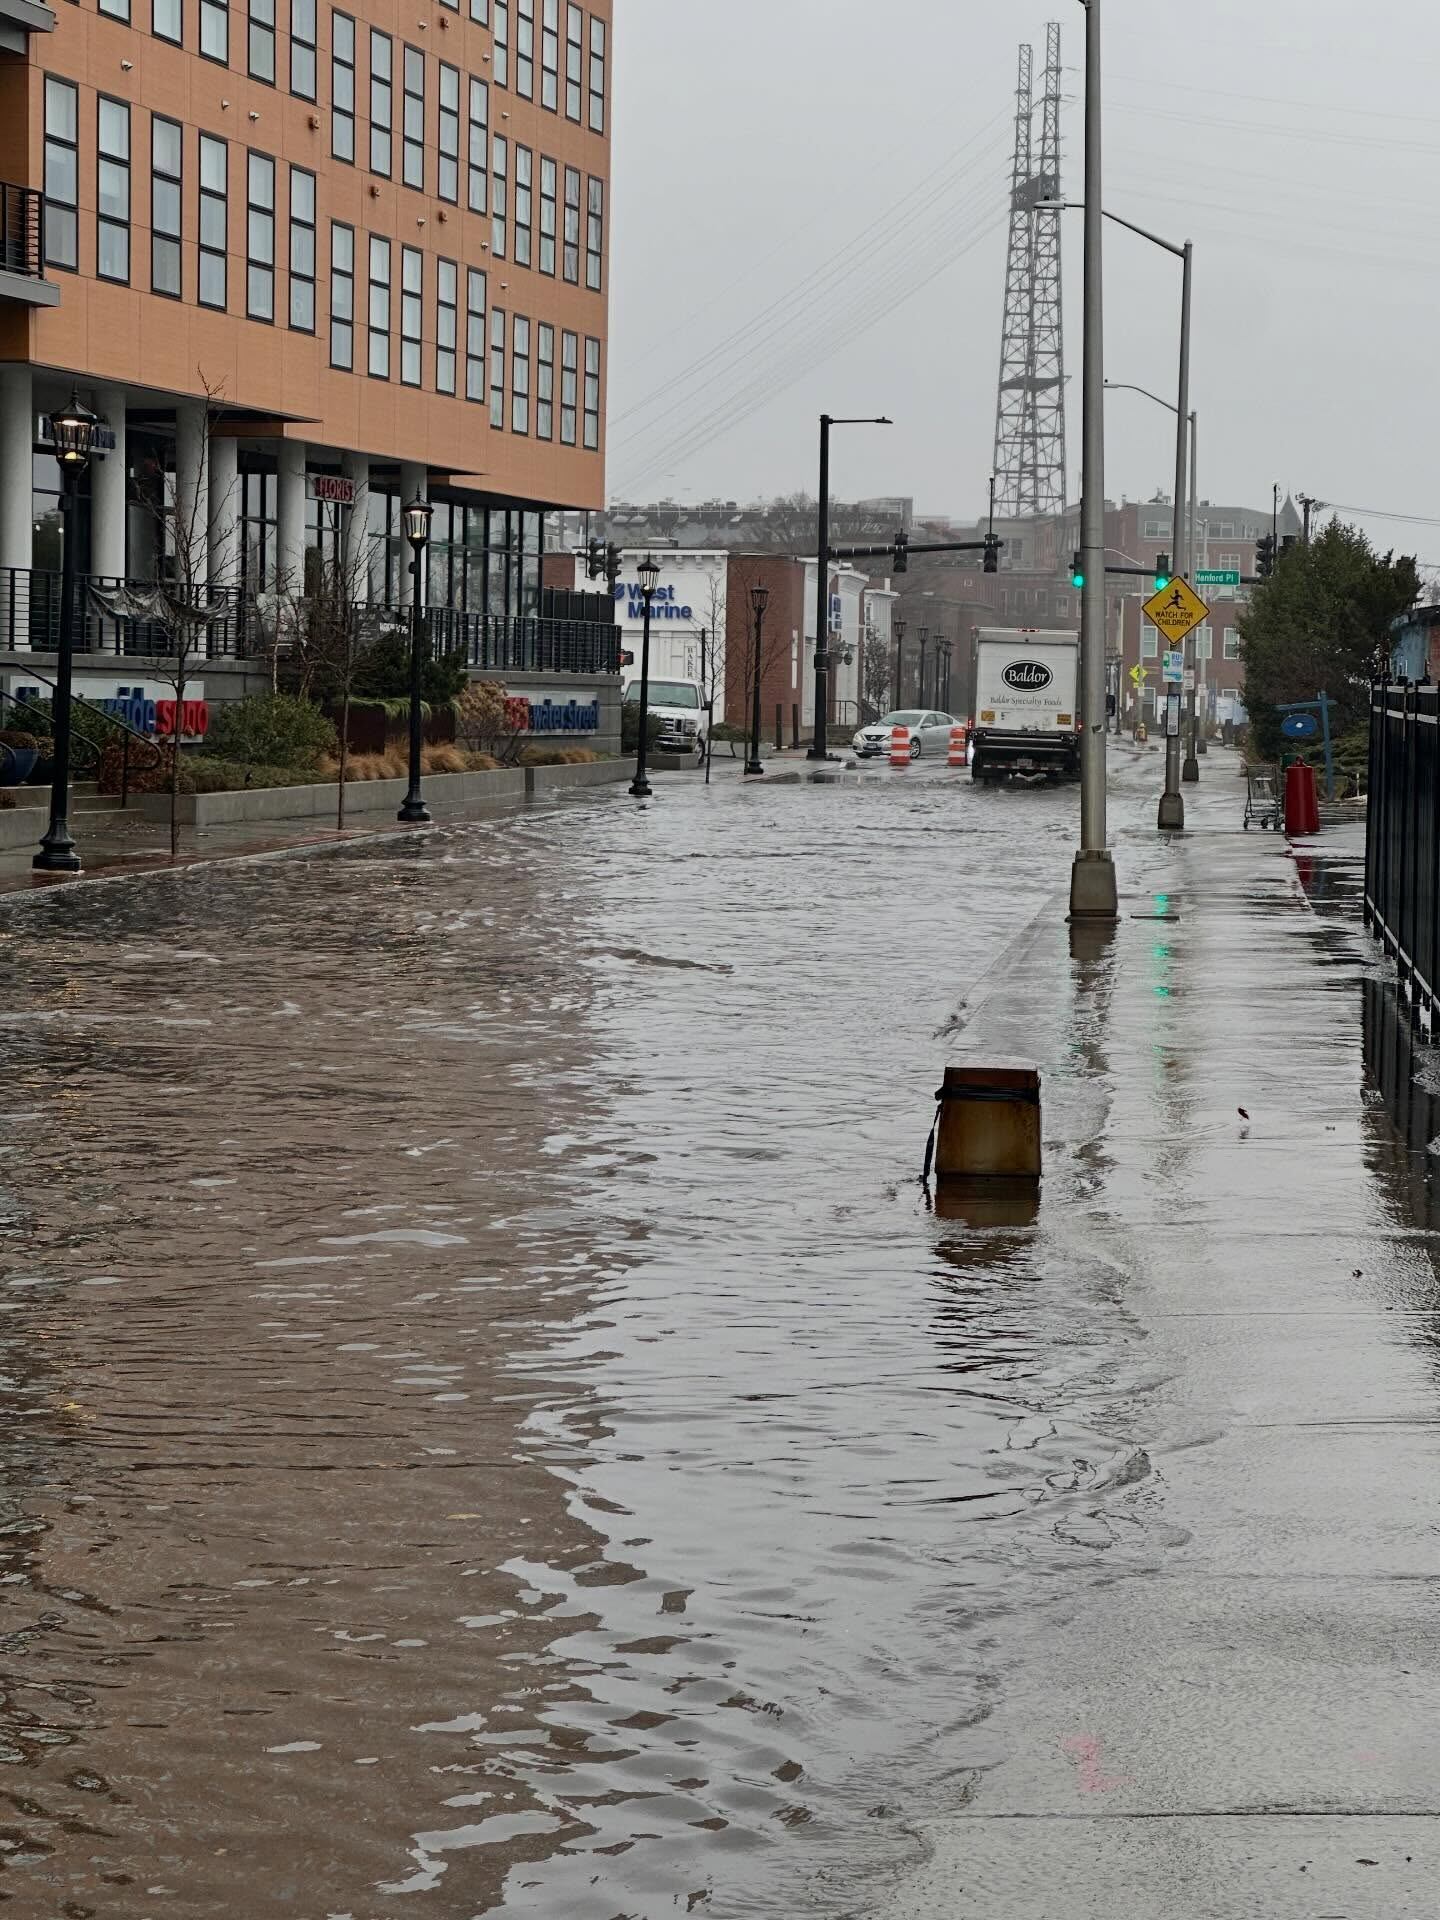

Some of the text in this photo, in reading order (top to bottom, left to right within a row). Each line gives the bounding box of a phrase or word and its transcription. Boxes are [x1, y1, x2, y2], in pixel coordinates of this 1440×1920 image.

[1195, 573, 1224, 582] Hanford
[628, 602, 692, 618] Marine
[1008, 665, 1048, 683] Baldor
[990, 695, 1010, 704] Baldor
[1012, 696, 1041, 706] Specialty
